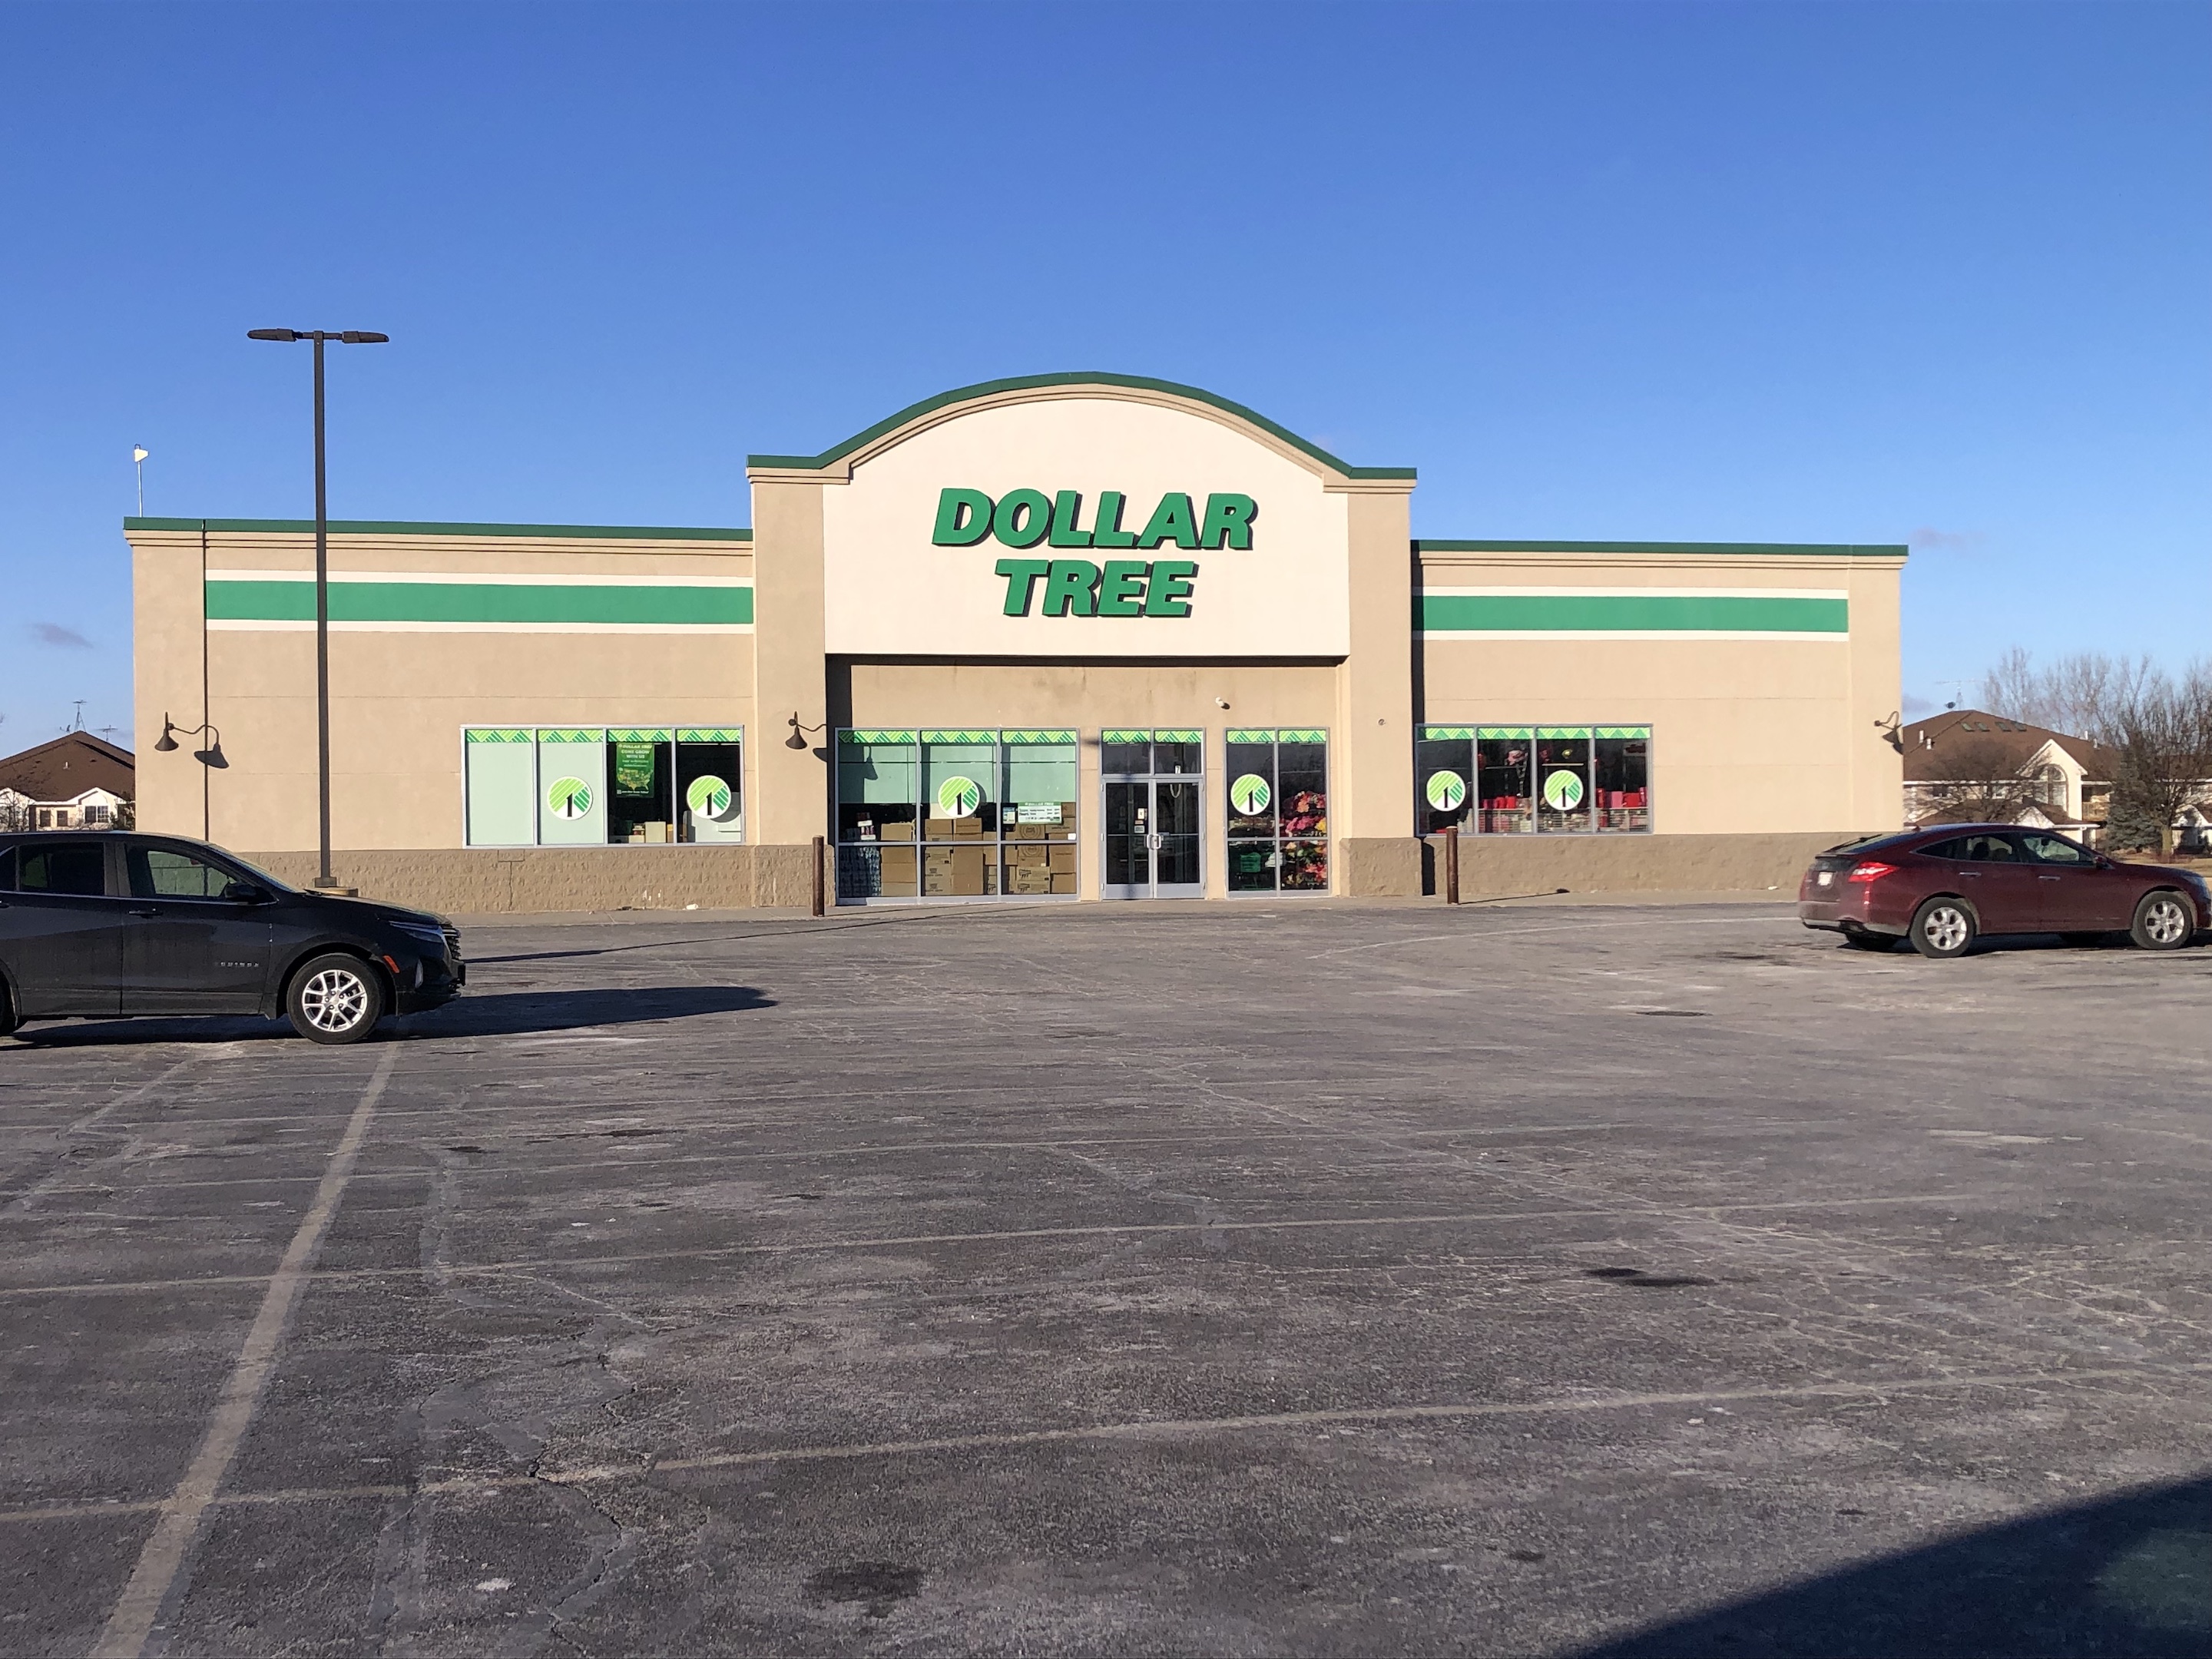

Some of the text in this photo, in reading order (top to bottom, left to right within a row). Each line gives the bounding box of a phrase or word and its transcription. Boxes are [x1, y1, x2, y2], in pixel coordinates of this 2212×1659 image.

[932, 488, 1258, 550] DOLLAR
[995, 559, 1199, 618] TREE
[566, 793, 573, 816] 1
[706, 792, 712, 816] 1
[956, 792, 962, 815] 1
[1247, 790, 1253, 812] 1
[1443, 786, 1448, 808] 1
[1561, 786, 1566, 807] 1
